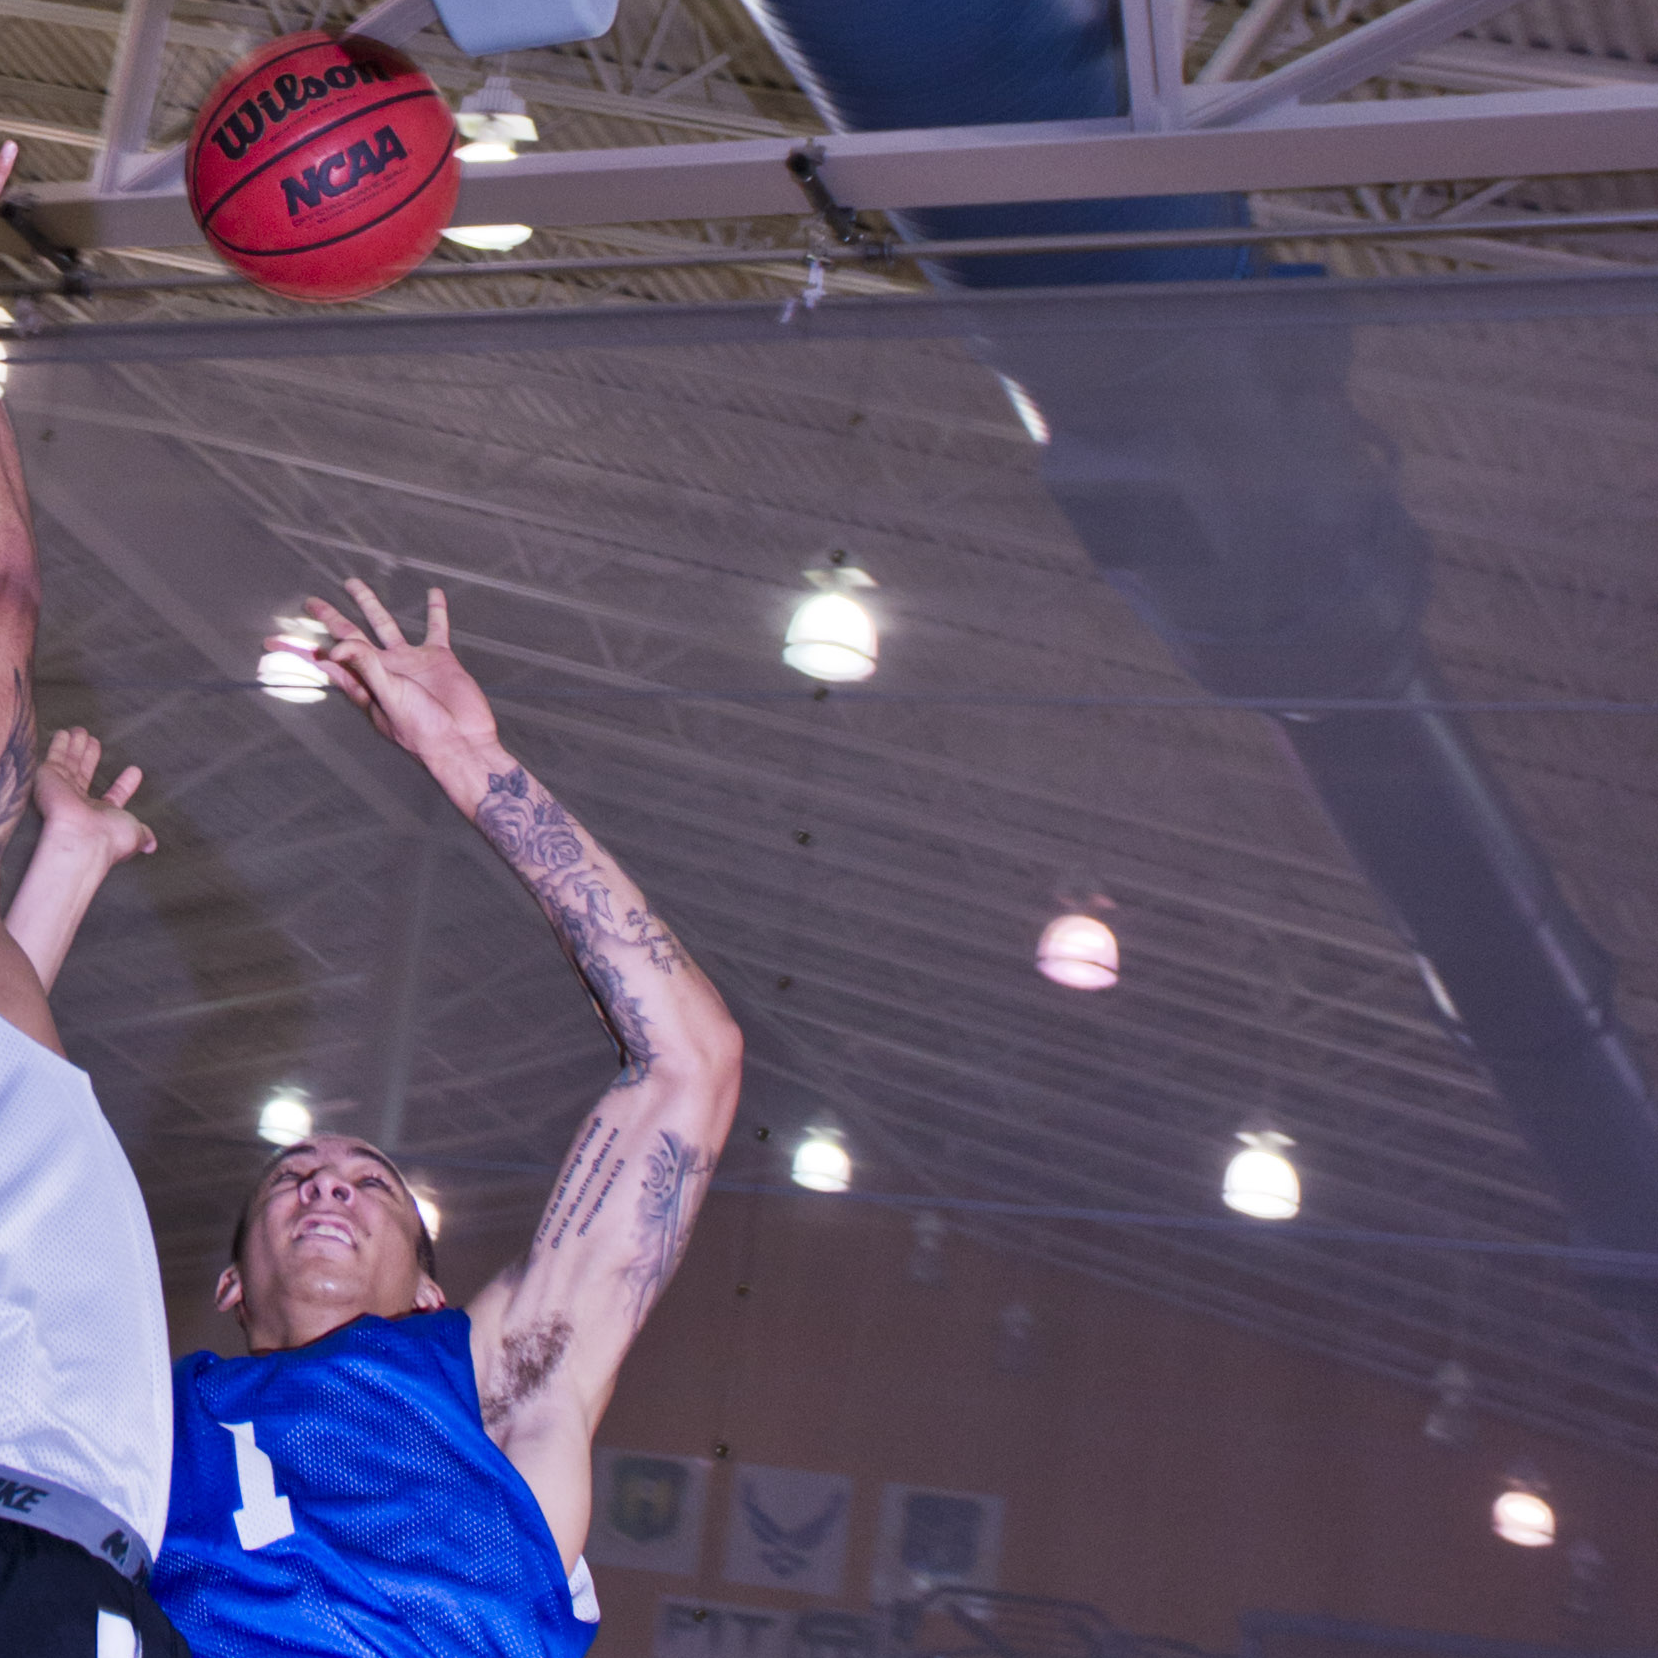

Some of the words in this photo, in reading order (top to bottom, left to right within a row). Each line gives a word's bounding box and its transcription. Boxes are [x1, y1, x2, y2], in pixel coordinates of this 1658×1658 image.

[210, 59, 395, 161] Wilson
[280, 125, 408, 217] NCAA
[541, 1217, 551, 1236] can
[549, 1202, 560, 1216] do
[563, 1153, 582, 1183] things
[579, 1117, 602, 1152] through
[551, 1218, 570, 1249] Christ
[217, 1421, 295, 1550] 1
